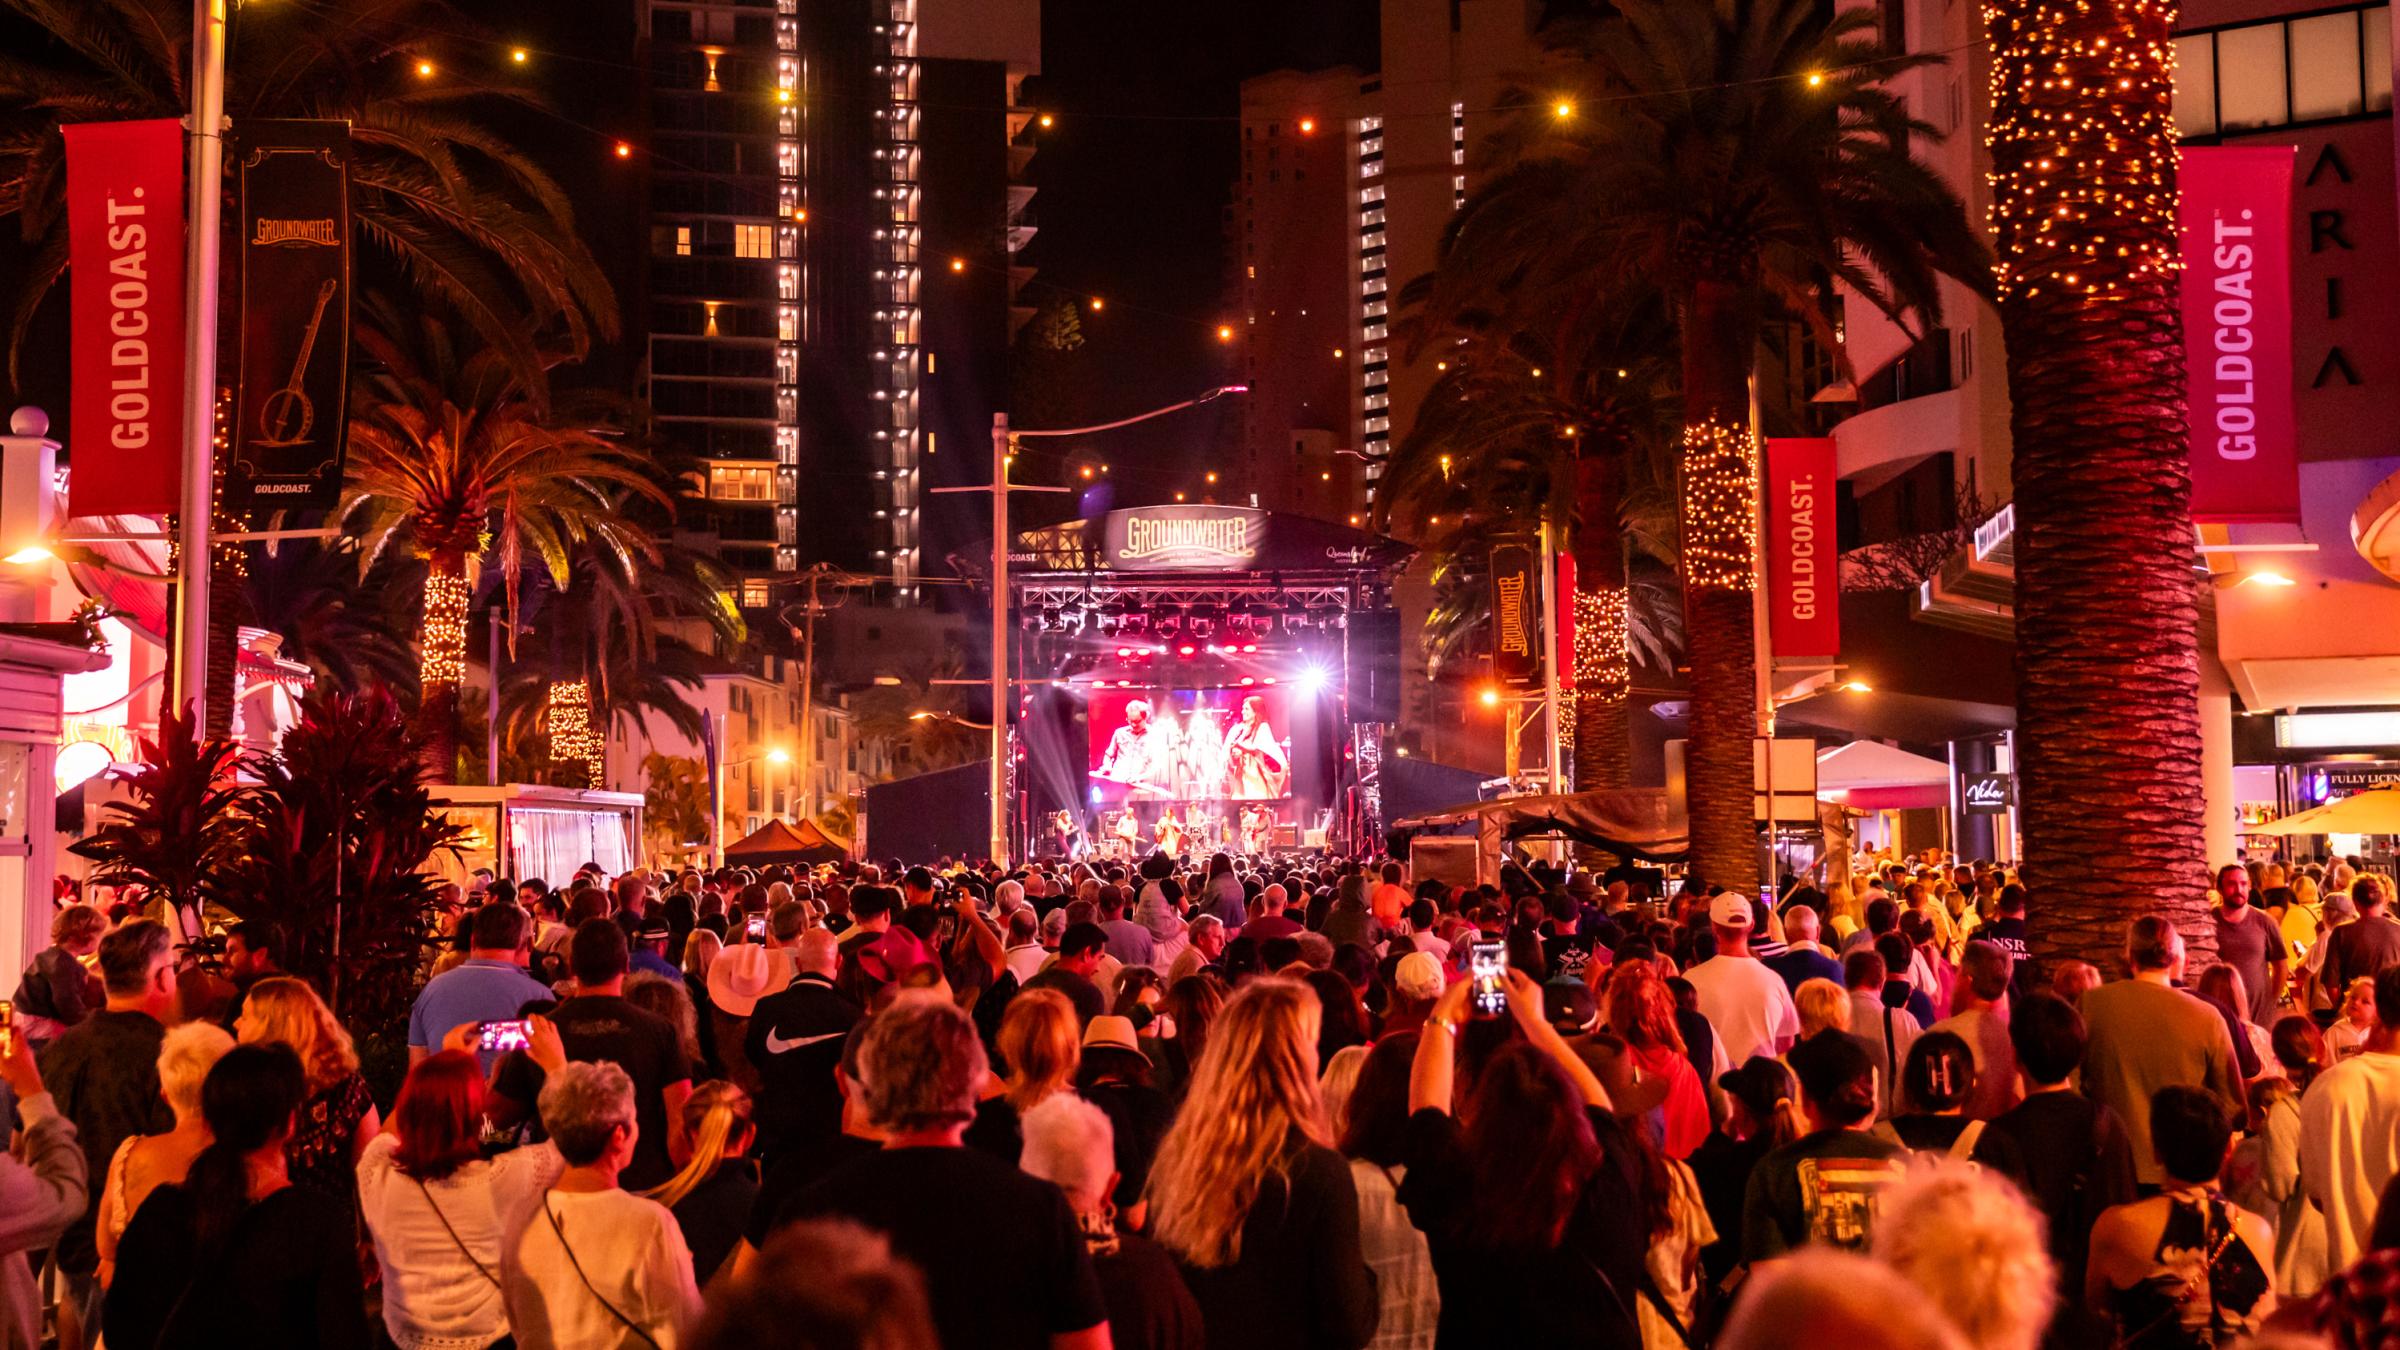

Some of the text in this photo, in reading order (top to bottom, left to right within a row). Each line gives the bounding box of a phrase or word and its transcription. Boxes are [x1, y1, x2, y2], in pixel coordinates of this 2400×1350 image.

[251, 217, 341, 246] GROUNDWATER
[107, 187, 150, 449] GOLDCOAST.
[2213, 208, 2257, 461] GOLDCOAST.
[1119, 516, 1256, 559] GROUNDWATER
[1790, 474, 1816, 620] GOLDCOAST.
[1498, 570, 1528, 657] GROUNDWATER
[2331, 774, 2366, 784] FULLY
